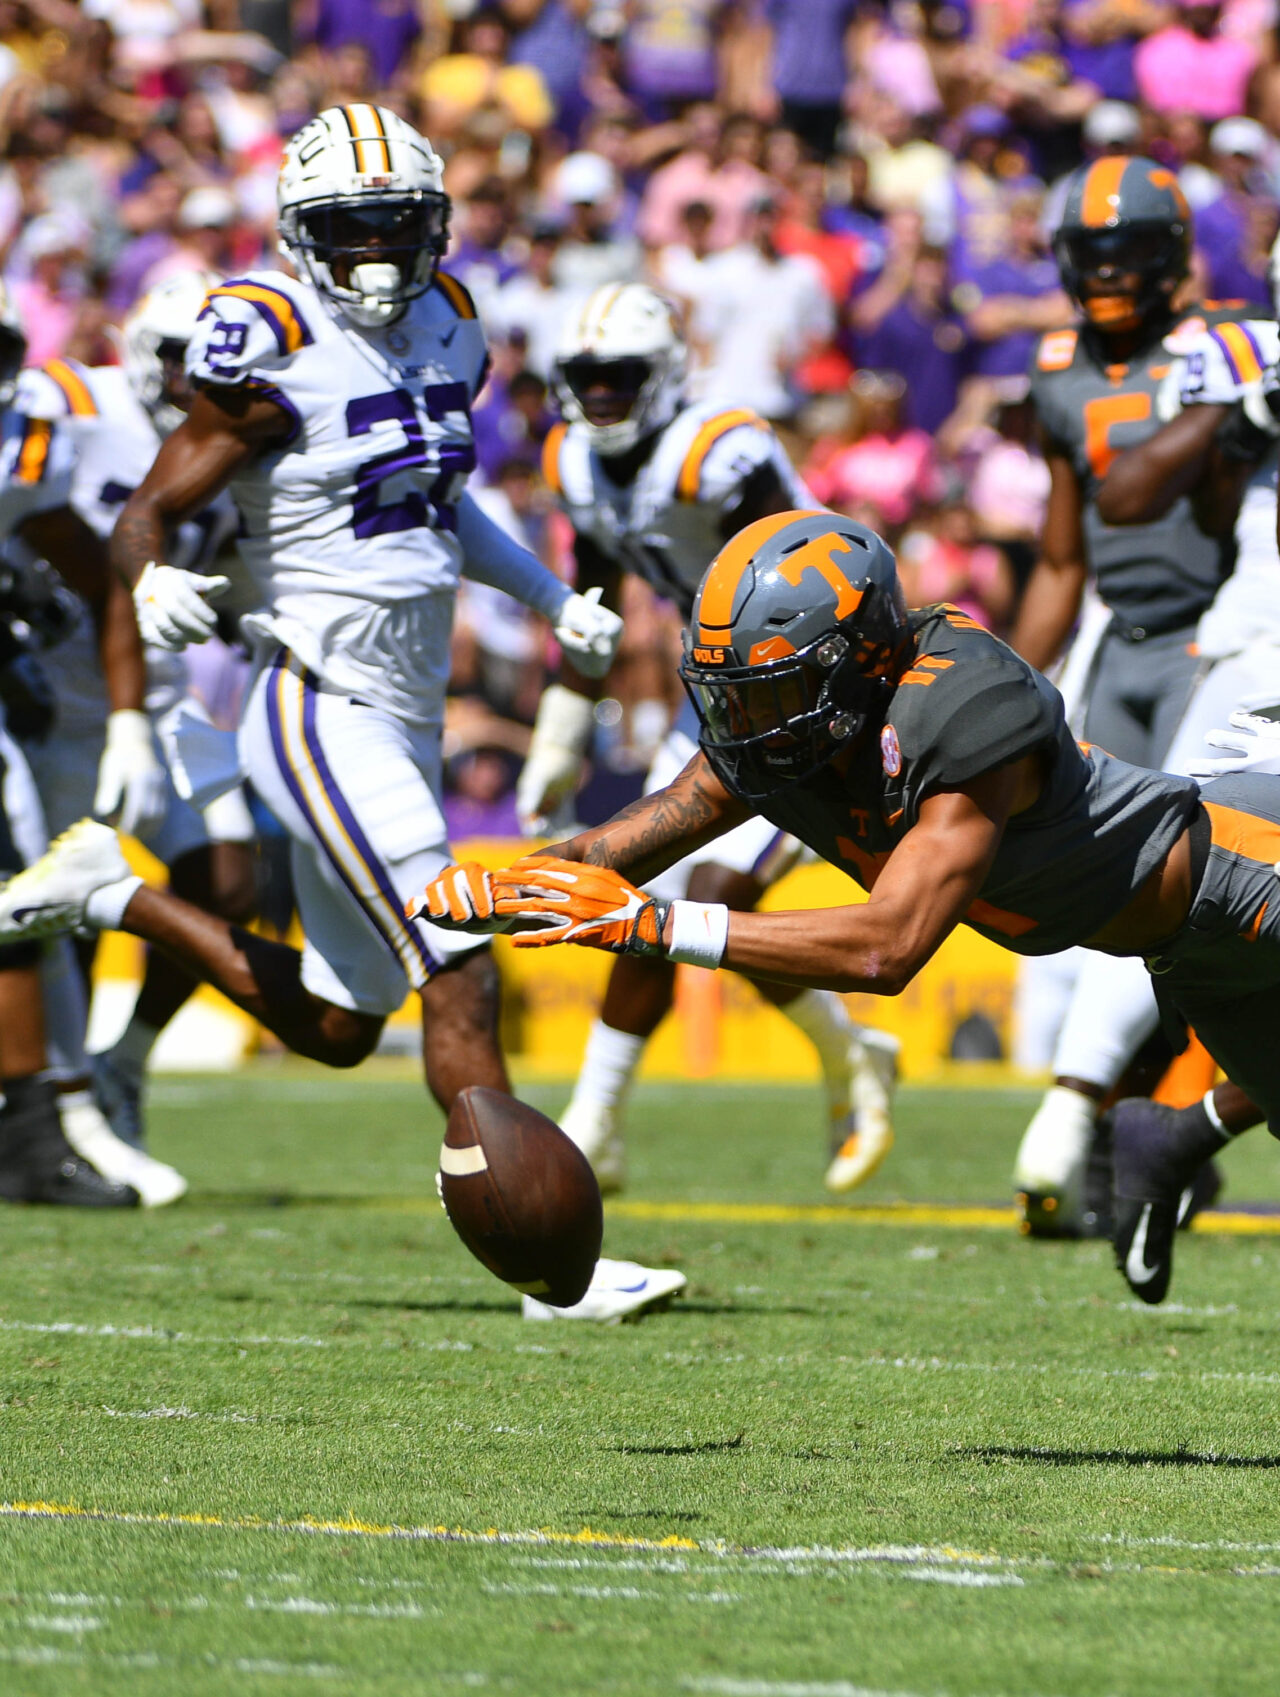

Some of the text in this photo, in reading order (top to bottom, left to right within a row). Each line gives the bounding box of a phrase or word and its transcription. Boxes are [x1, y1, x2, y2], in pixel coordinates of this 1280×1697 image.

[777, 531, 865, 621] T
[693, 647, 725, 664] VOLS
[850, 808, 870, 837] T
